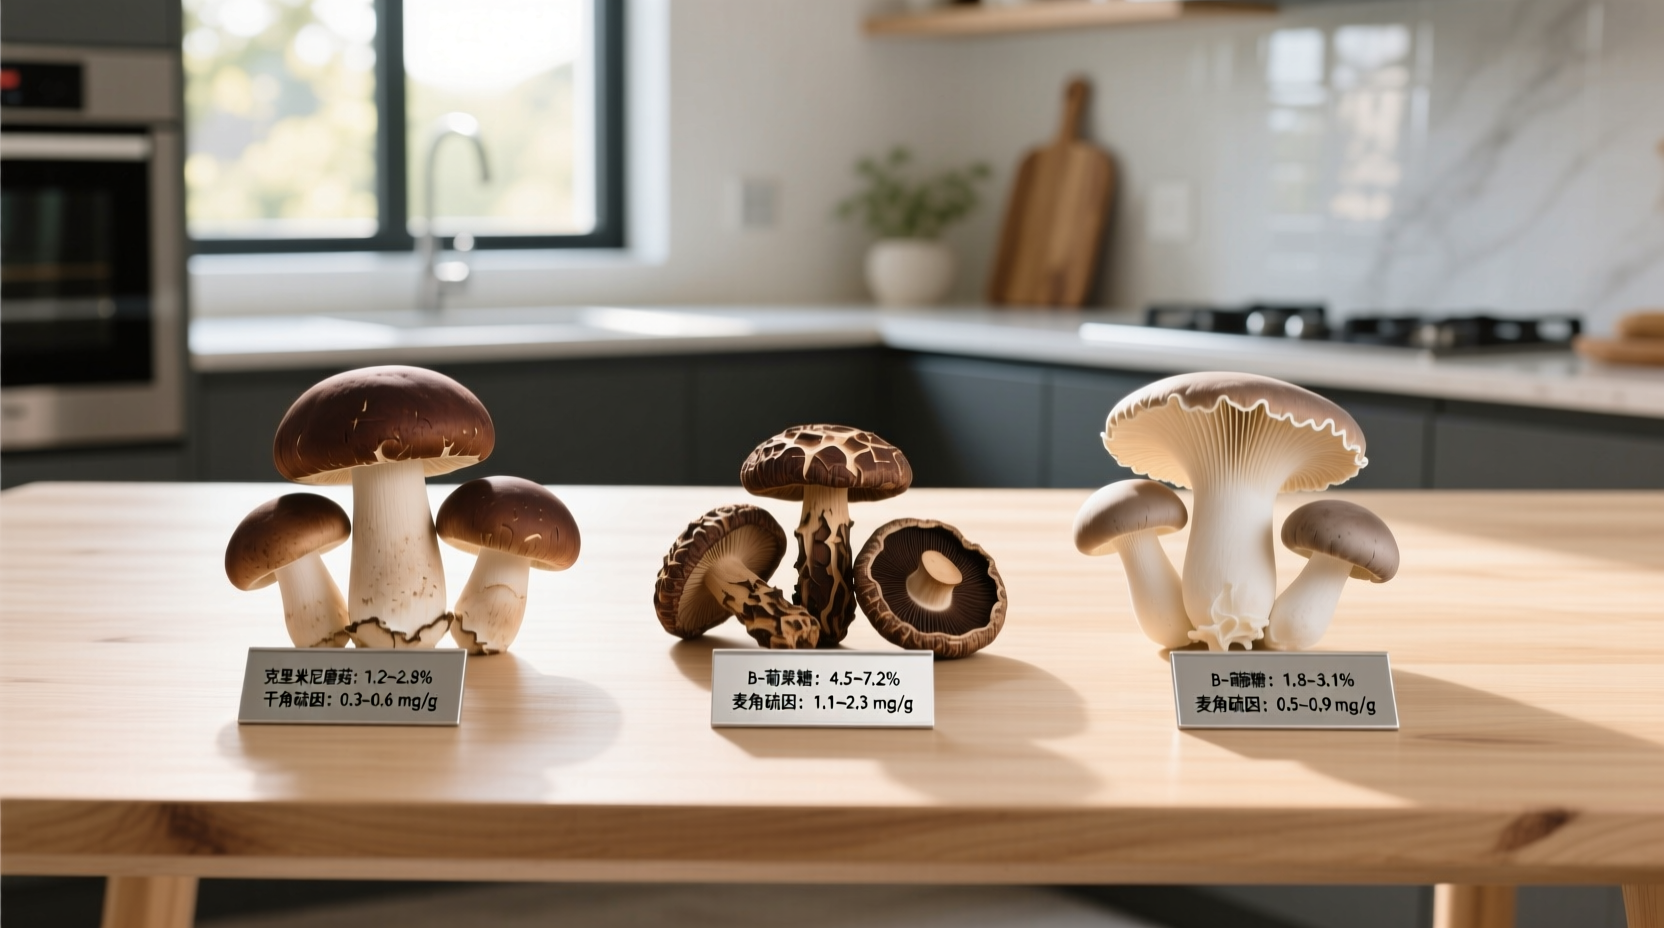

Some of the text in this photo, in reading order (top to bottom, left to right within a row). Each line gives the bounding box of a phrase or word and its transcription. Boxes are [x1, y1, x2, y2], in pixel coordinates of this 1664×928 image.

[830, 671, 901, 687] 4.5-7.2%
[1282, 672, 1355, 688] 1.8-3.1%
[339, 691, 394, 708] 0.3-0.6
[397, 691, 438, 712] mg/g
[814, 694, 868, 710] 1.1-2.3
[873, 694, 914, 714] mg/g
[1276, 696, 1332, 713] 0.5-0.9
[1334, 695, 1377, 716] mg/g
